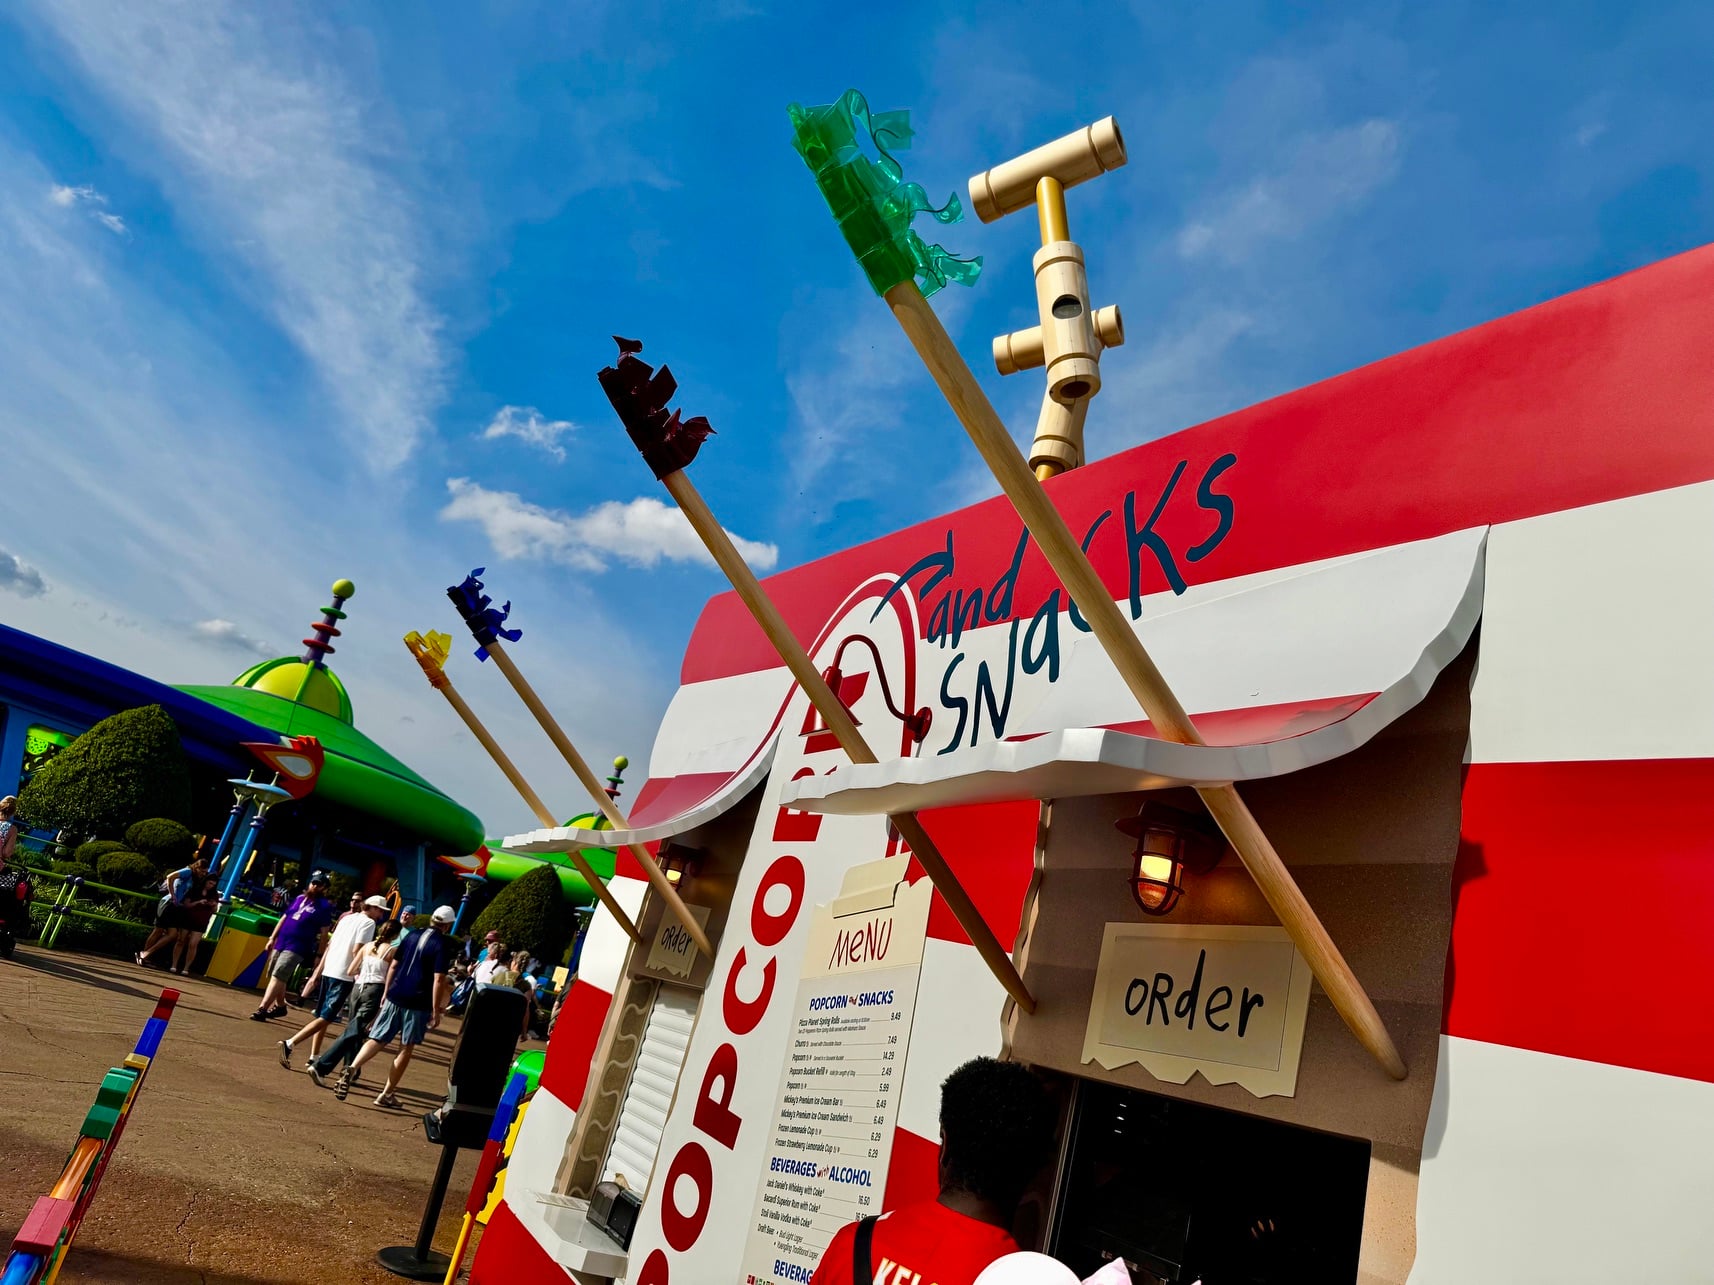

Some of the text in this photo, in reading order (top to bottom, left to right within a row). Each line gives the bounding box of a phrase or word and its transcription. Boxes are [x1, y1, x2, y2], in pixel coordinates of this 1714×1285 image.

[927, 524, 1030, 649] and
[809, 994, 848, 1011] POPCORN
[858, 990, 894, 1007] SNACKS
[820, 1017, 831, 1027] Spring
[831, 1016, 840, 1025] Rolls
[888, 1036, 897, 1045] 7.49
[792, 1053, 806, 1063] Popcorn
[883, 1051, 894, 1061] 14.29
[789, 1067, 803, 1077] Popcorn
[803, 1066, 816, 1075] Bucket
[816, 1066, 825, 1075] Refill
[881, 1067, 892, 1076] 2.49
[786, 1081, 889, 1092] Popcorn 5.99
[784, 1095, 798, 1106] Mickey's
[799, 1096, 814, 1105] Premium
[820, 1097, 832, 1105] Cream
[876, 1099, 887, 1108] 6.49
[781, 1109, 796, 1120] Mickey's
[796, 1110, 811, 1119] Premium
[817, 1112, 829, 1121] Cream
[830, 1113, 848, 1122] Sandwich
[873, 1116, 884, 1125] 6.49
[778, 1124, 881, 1141] Frozen Lemonade Cup 6.29
[775, 1138, 878, 1158] Frozen Strawberry Lemonade Cup 6.29
[770, 1157, 872, 1187] BEVERAGES with ALCOHOL
[766, 1179, 775, 1188] Jack
[774, 1180, 788, 1190] Daniel's
[788, 1182, 803, 1195] Whiskey
[804, 1185, 812, 1194] with
[858, 1195, 870, 1205] 16.50
[777, 1196, 791, 1207] Superior
[791, 1199, 799, 1209] Rum
[800, 1201, 808, 1210] with
[769, 1210, 780, 1220] Vanilla
[780, 1213, 791, 1223] Vodka
[791, 1216, 800, 1225] with
[757, 1223, 767, 1232] Draft
[767, 1226, 775, 1235] Beer
[793, 1233, 804, 1244] Lager
[777, 1241, 819, 1260] Yuengling Traditional Lager
